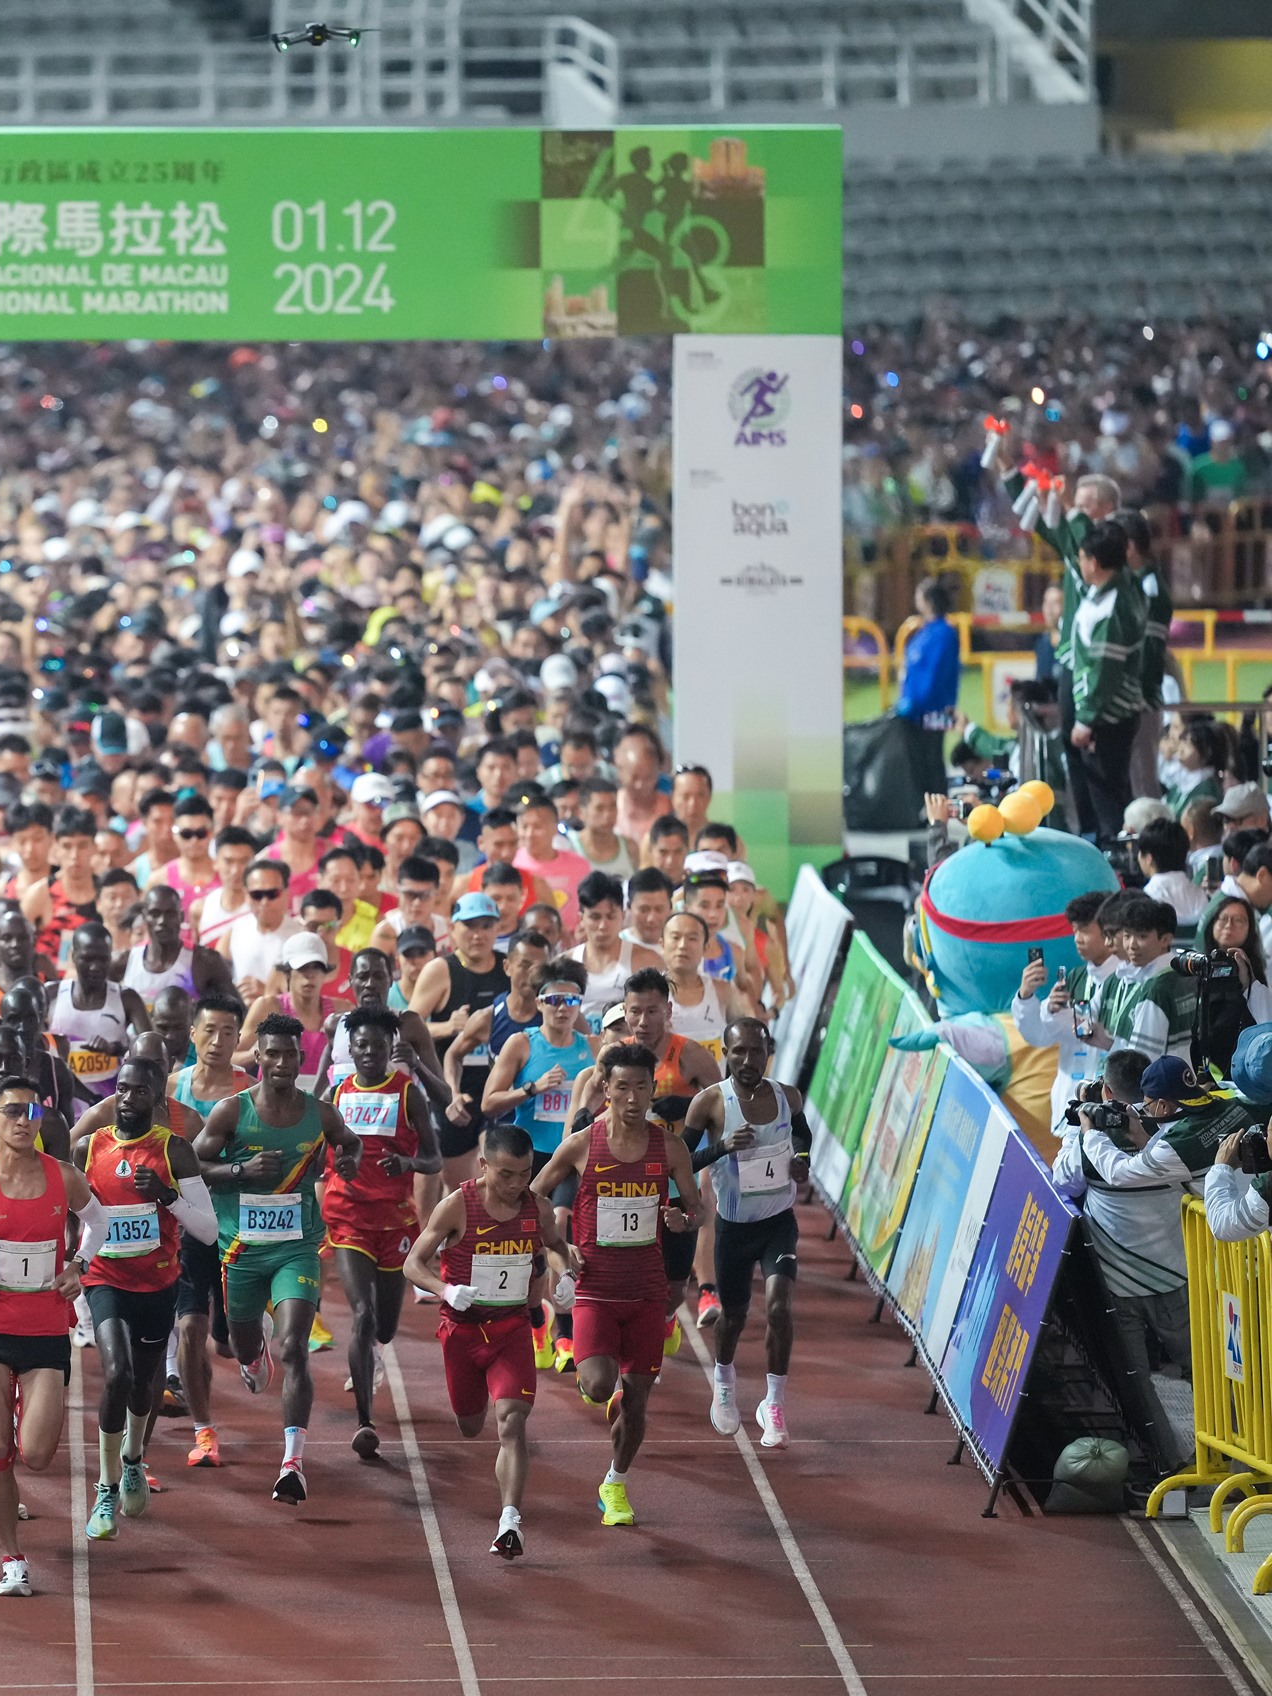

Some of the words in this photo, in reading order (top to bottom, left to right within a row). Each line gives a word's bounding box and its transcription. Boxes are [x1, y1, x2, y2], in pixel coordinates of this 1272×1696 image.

[272, 200, 396, 252] 01.12
[102, 263, 134, 286] DE
[139, 263, 228, 286] MACAU
[273, 262, 395, 315] 2024
[81, 291, 228, 315] MARATHON
[734, 429, 788, 447] AIMS
[731, 499, 776, 517] bon
[732, 518, 790, 538] aqua
[69, 1054, 112, 1073] A2059
[543, 1093, 569, 1111] B81
[344, 1106, 391, 1125] B7477
[765, 1160, 775, 1179] 4
[595, 1181, 659, 1198] CHINA
[247, 1209, 295, 1230] B3242
[621, 1212, 639, 1232] 13
[475, 1238, 534, 1255] CHINA
[21, 1257, 29, 1277] 1
[498, 1270, 508, 1290] 2
